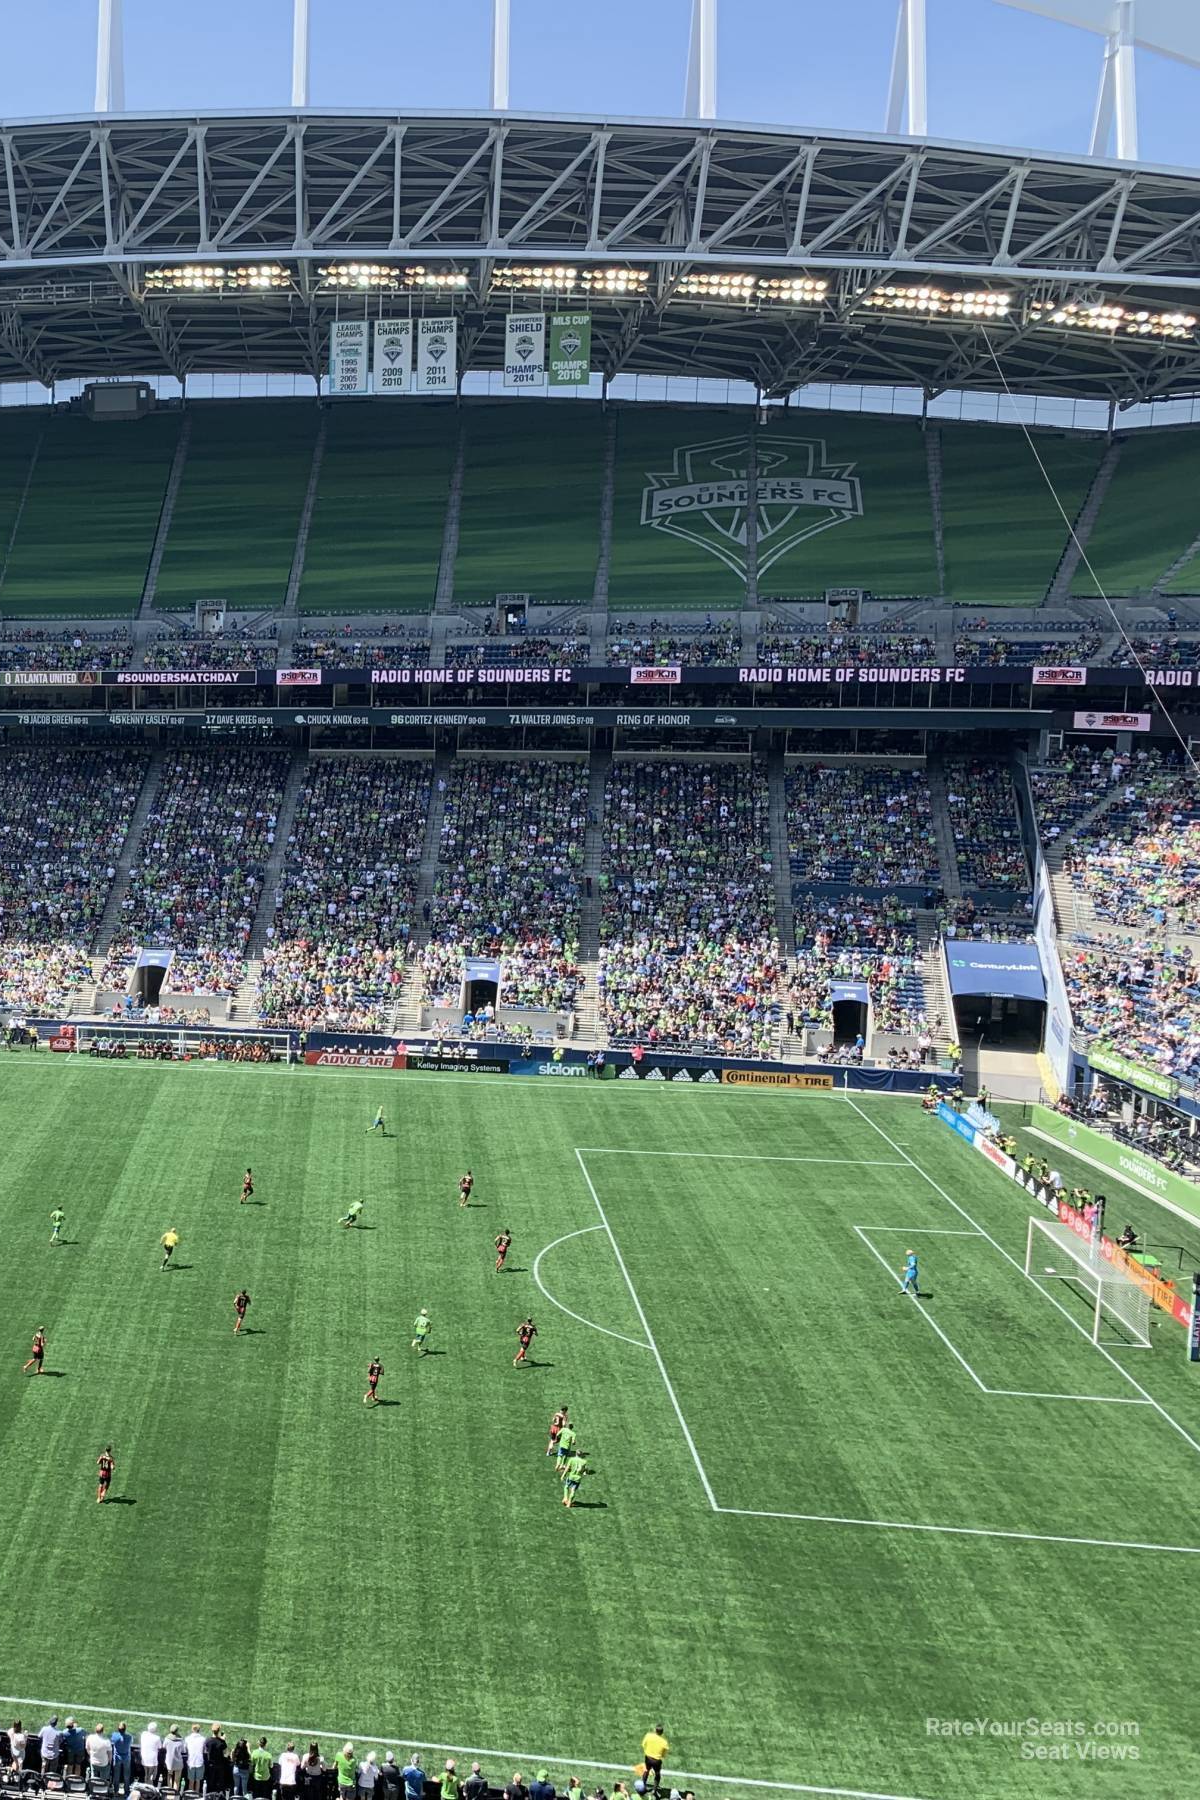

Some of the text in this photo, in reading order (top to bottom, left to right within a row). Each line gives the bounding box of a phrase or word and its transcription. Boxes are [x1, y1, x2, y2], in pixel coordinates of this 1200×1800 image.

[552, 315, 589, 326] MLS CUP
[378, 326, 410, 336] CHAMPS
[421, 325, 454, 334] CHAMPS
[510, 323, 542, 333] SHIELD
[506, 364, 543, 374] CHAMPS
[552, 360, 587, 370] CHAMPS
[382, 368, 403, 377] 2009
[426, 366, 446, 375] 2011
[558, 370, 581, 380] 2016
[382, 377, 402, 386] 2010
[426, 375, 446, 384] 2014
[514, 374, 534, 382] 2014
[813, 489, 846, 504] FC
[5, 674, 11, 684] 0
[14, 674, 48, 684] ATLANTA
[50, 673, 76, 684] UNITED
[117, 672, 238, 683] #SOUNDERSMATCHDAY
[372, 669, 571, 683] RADIO HOME OF SOUNDERS FC
[740, 668, 964, 682] RADIO HOME OF SOUNDERS FC
[1145, 671, 1191, 686] RADIO
[30, 716, 50, 724] JACOB
[52, 716, 73, 724] GREEN
[122, 716, 144, 724] KENNY
[145, 716, 170, 724] EASLEY
[217, 716, 234, 724] DAVE
[236, 716, 257, 724] KRIEG
[307, 715, 352, 724] CHUCK KNOX
[405, 715, 432, 724] CORTEZ
[434, 715, 467, 724] KENNEDY
[510, 715, 576, 724] 71 WALTER JONES
[617, 715, 690, 724] RING OF HONOR
[970, 961, 1038, 971] CenturyLink
[317, 1054, 393, 1067] ADVOCARE
[418, 1061, 500, 1074] Kelley Imaging Systems
[539, 1063, 585, 1076] slalom
[726, 1070, 829, 1086] Continental TIRE
[1120, 1156, 1156, 1184] SOUNDERS
[1157, 1177, 1168, 1190] FC
